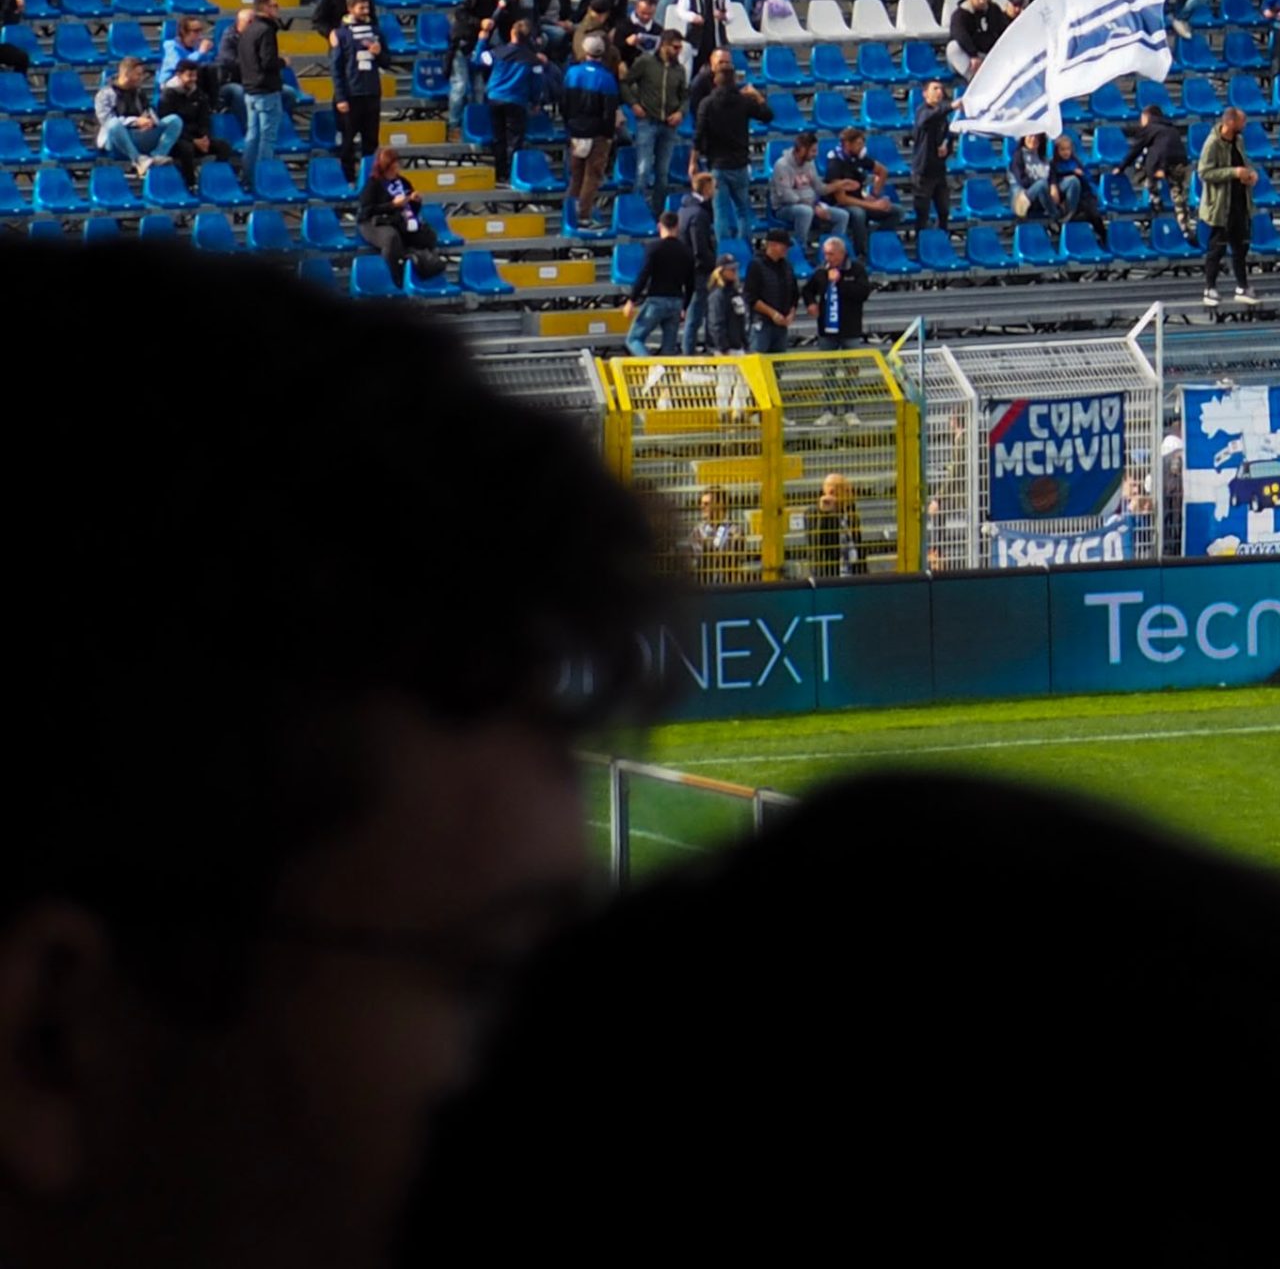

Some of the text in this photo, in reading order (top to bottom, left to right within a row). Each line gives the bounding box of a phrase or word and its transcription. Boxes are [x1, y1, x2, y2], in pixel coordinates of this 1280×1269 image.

[1029, 396, 1121, 439] COMO
[994, 433, 1121, 478] MCMVII
[642, 614, 844, 689] NEXT
